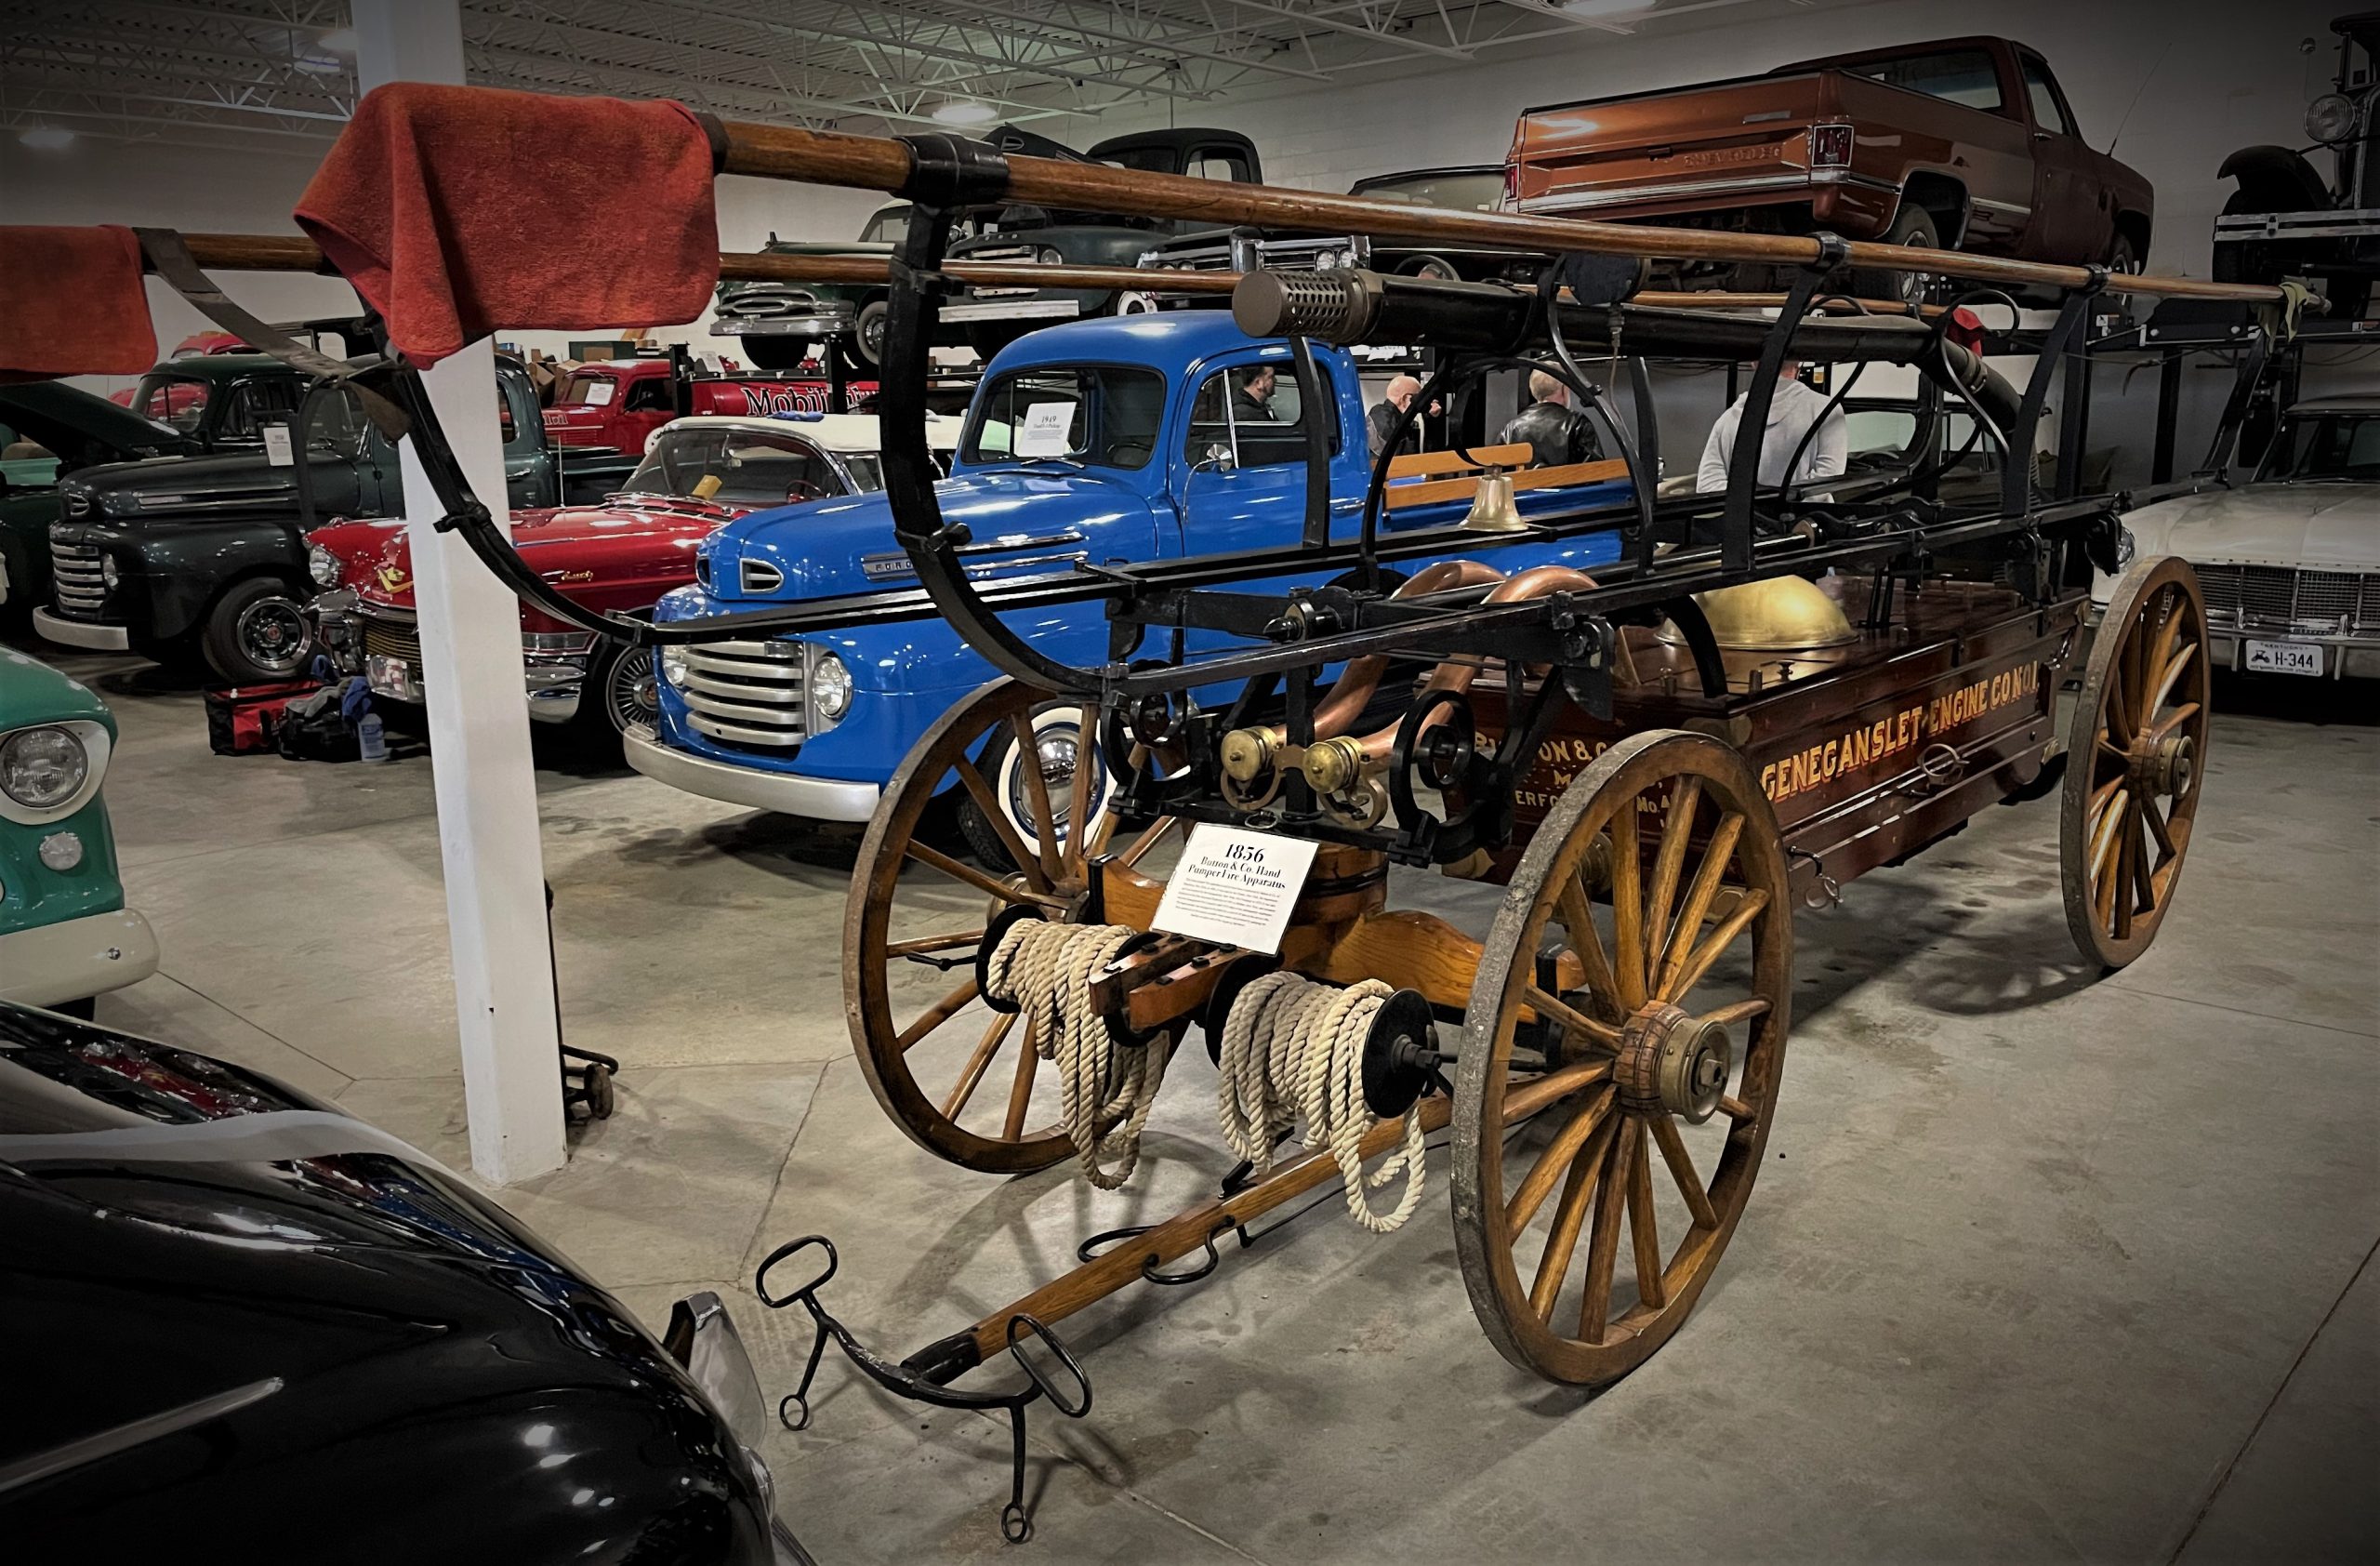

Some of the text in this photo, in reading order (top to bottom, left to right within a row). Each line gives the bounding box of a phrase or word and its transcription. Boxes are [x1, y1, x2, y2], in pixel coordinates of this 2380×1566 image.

[2275, 652, 2313, 668] H-344
[1573, 739, 1593, 762] &
[1761, 706, 1924, 803] GENEGANSLET
[1927, 679, 1989, 737] ENGINE
[1225, 843, 1264, 863] 1856
[1188, 864, 1286, 890] Pumper Fire Apparatus
[1200, 856, 1282, 879] Button & Co. Hand
